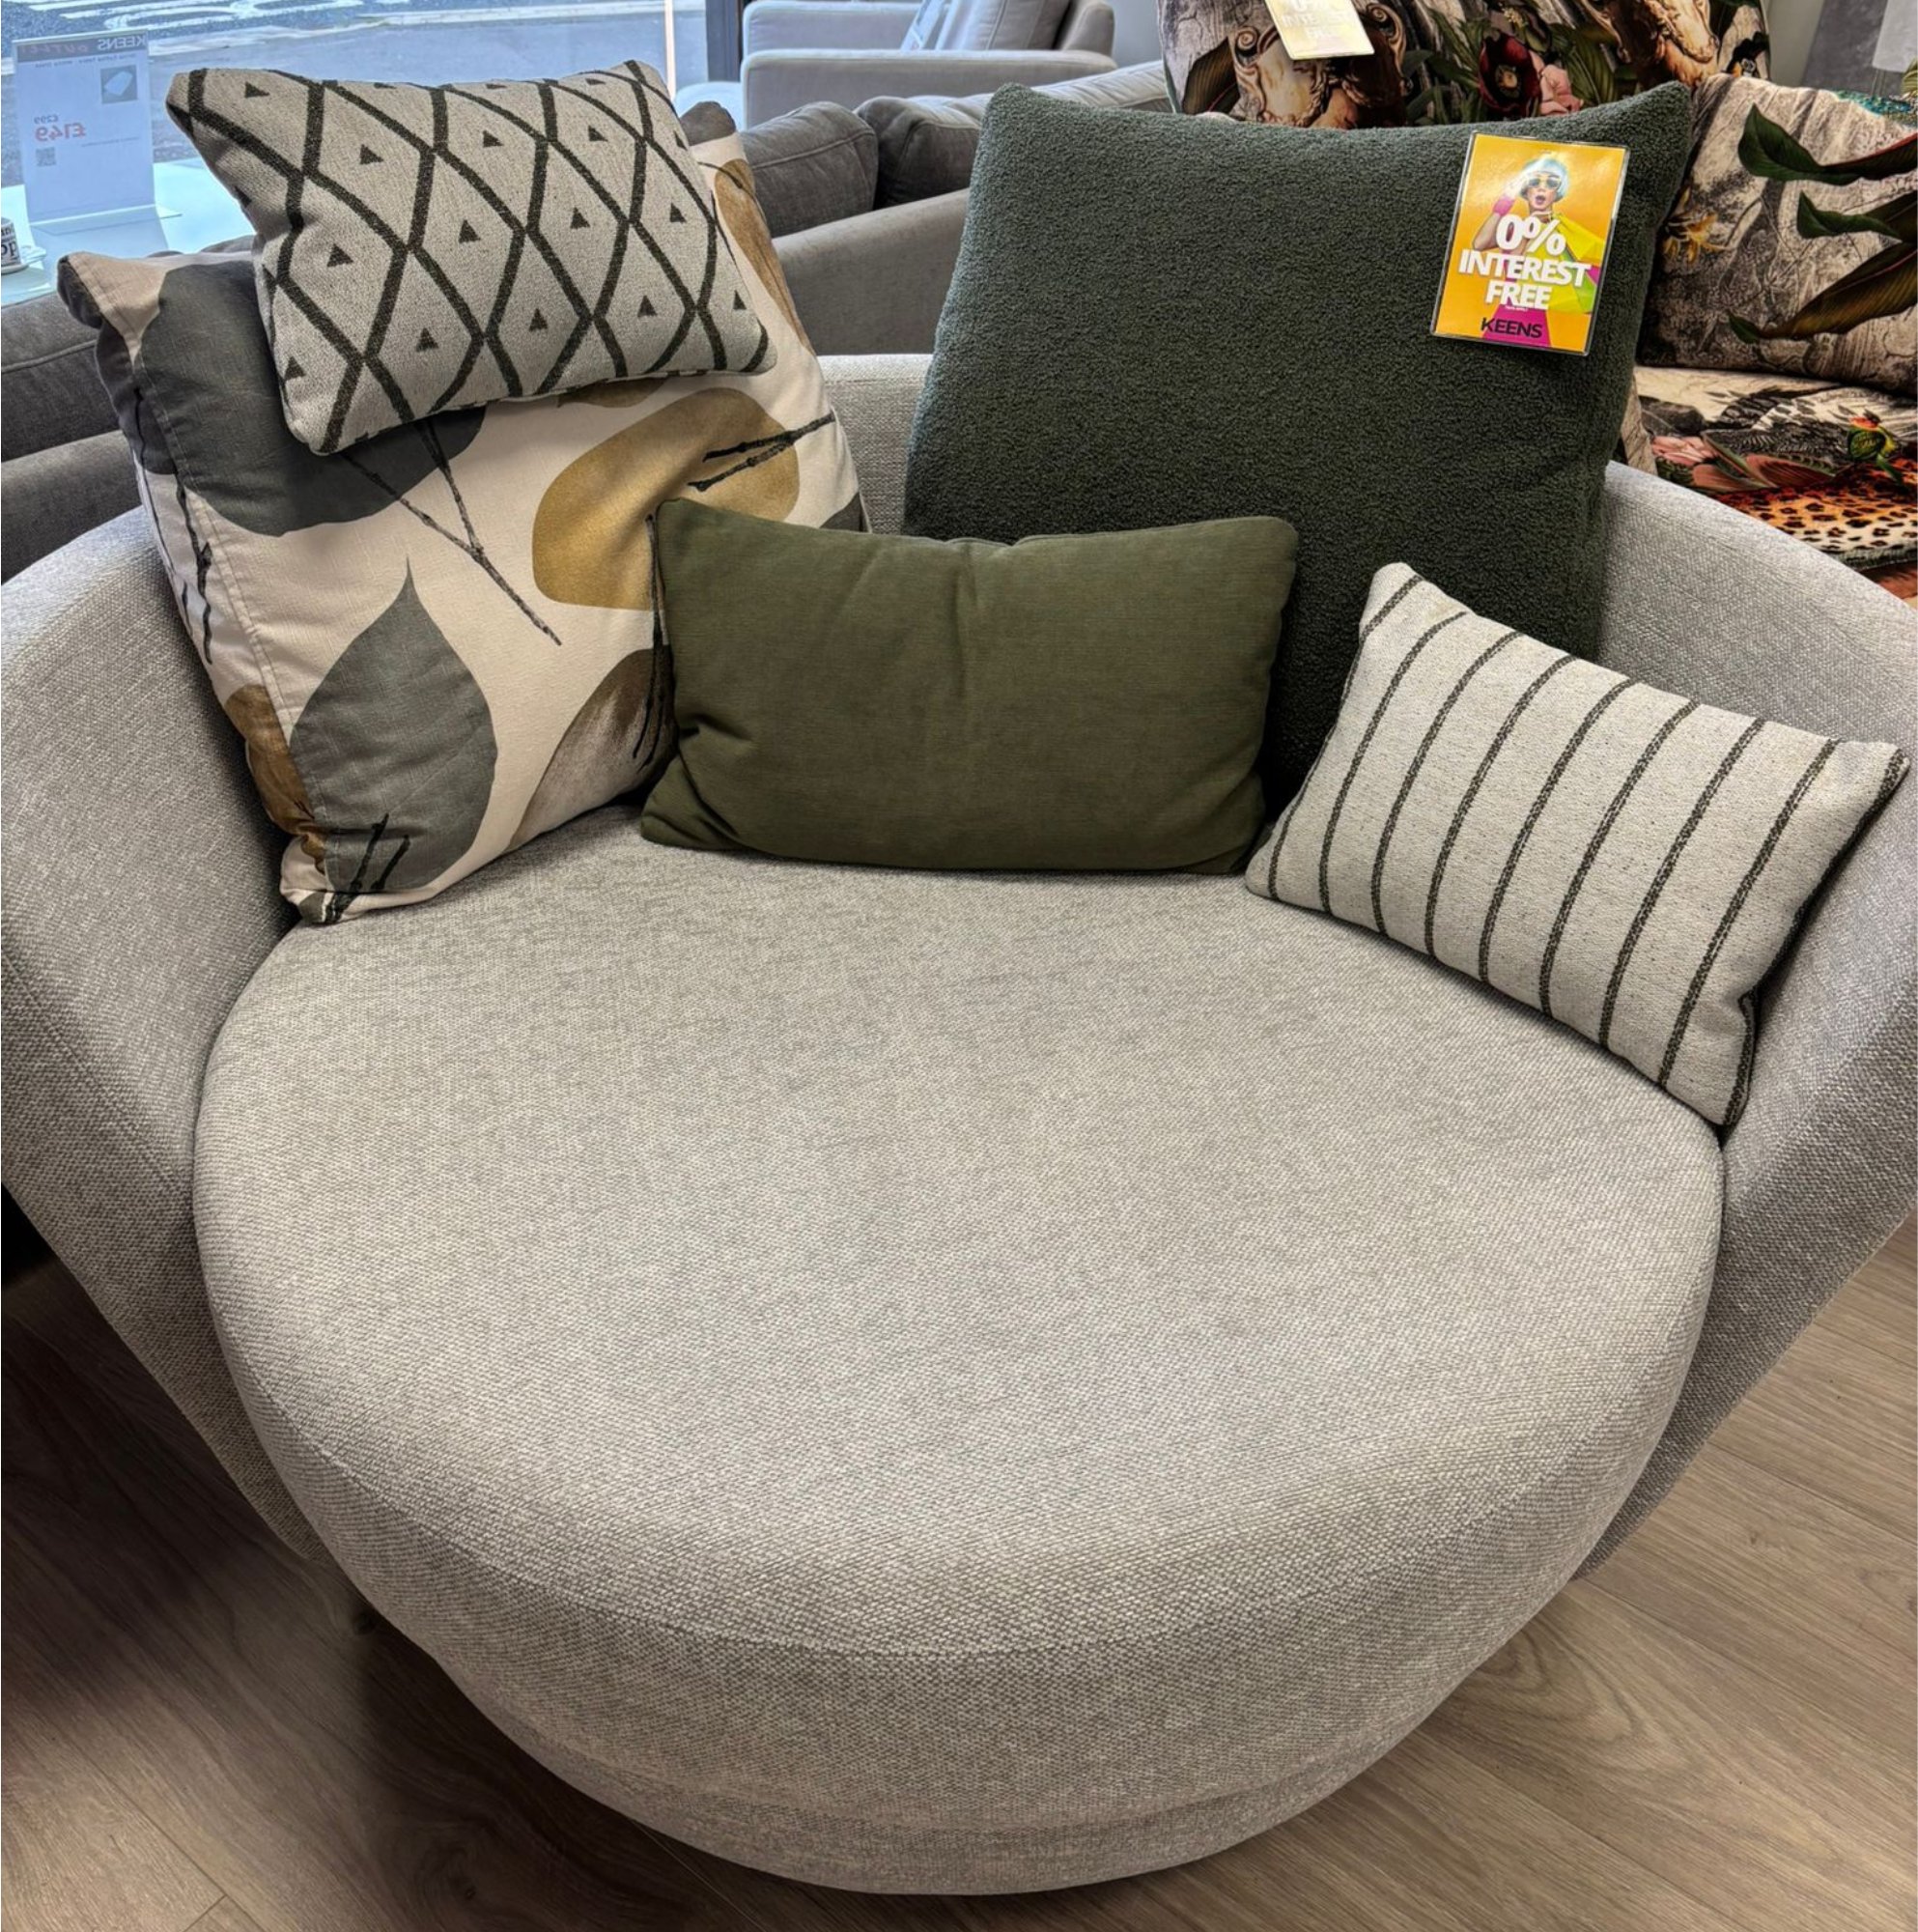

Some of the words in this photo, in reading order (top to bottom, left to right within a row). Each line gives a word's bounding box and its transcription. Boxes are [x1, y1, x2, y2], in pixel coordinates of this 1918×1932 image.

[1495, 213, 1566, 256] 0%
[1458, 248, 1592, 287] INTEREST
[1485, 279, 1553, 310] FREE
[1480, 317, 1543, 338] KEENS
